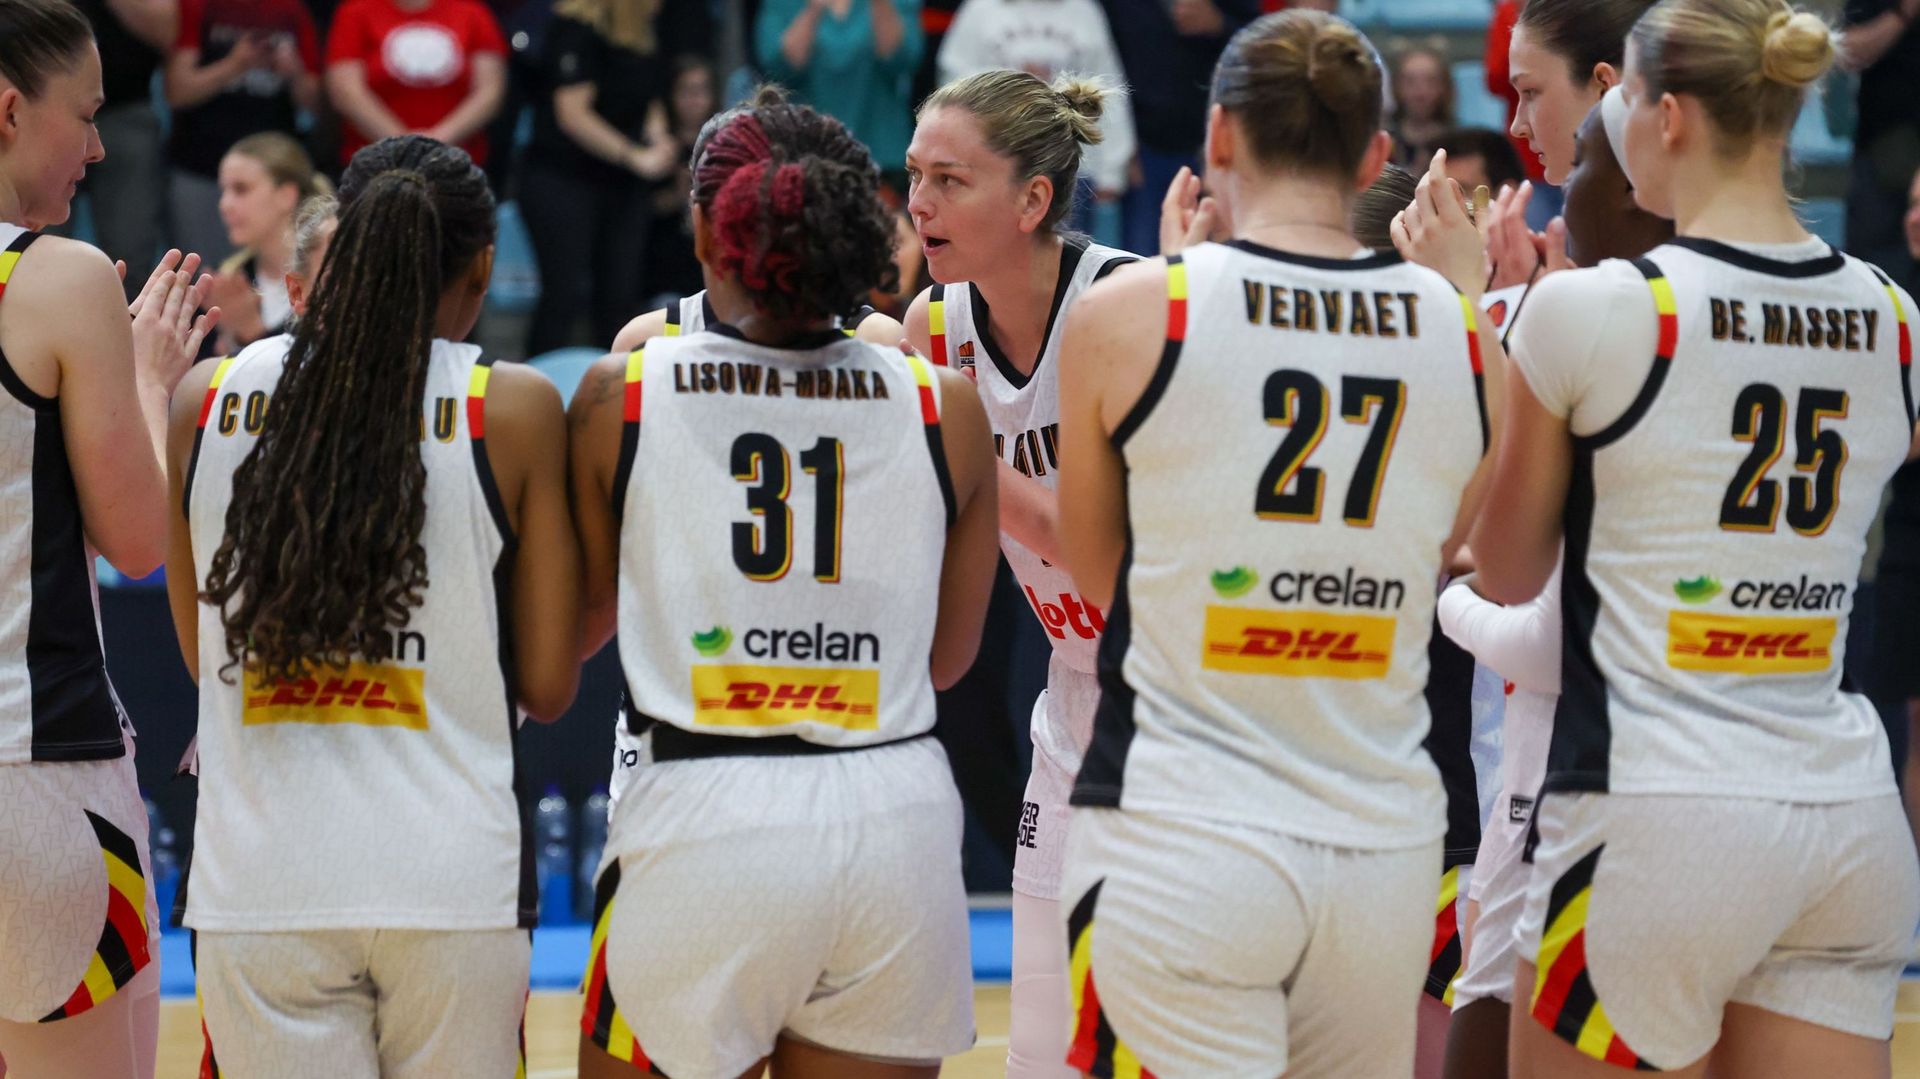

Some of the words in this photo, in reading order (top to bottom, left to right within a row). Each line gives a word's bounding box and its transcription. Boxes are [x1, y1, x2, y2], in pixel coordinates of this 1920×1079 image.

[1243, 279, 1420, 338] VERVAET
[674, 362, 889, 400] LISOWA-MBAKA
[1255, 369, 1407, 528] 27
[1719, 382, 1850, 538] 25
[730, 432, 844, 584] 31
[1270, 567, 1405, 609] crelan
[1730, 575, 1847, 610] crelan
[744, 622, 880, 662] crelan
[1238, 626, 1360, 662] DHL
[1702, 630, 1810, 659] DHL
[269, 677, 396, 709] DHL
[726, 681, 848, 712] DHL
